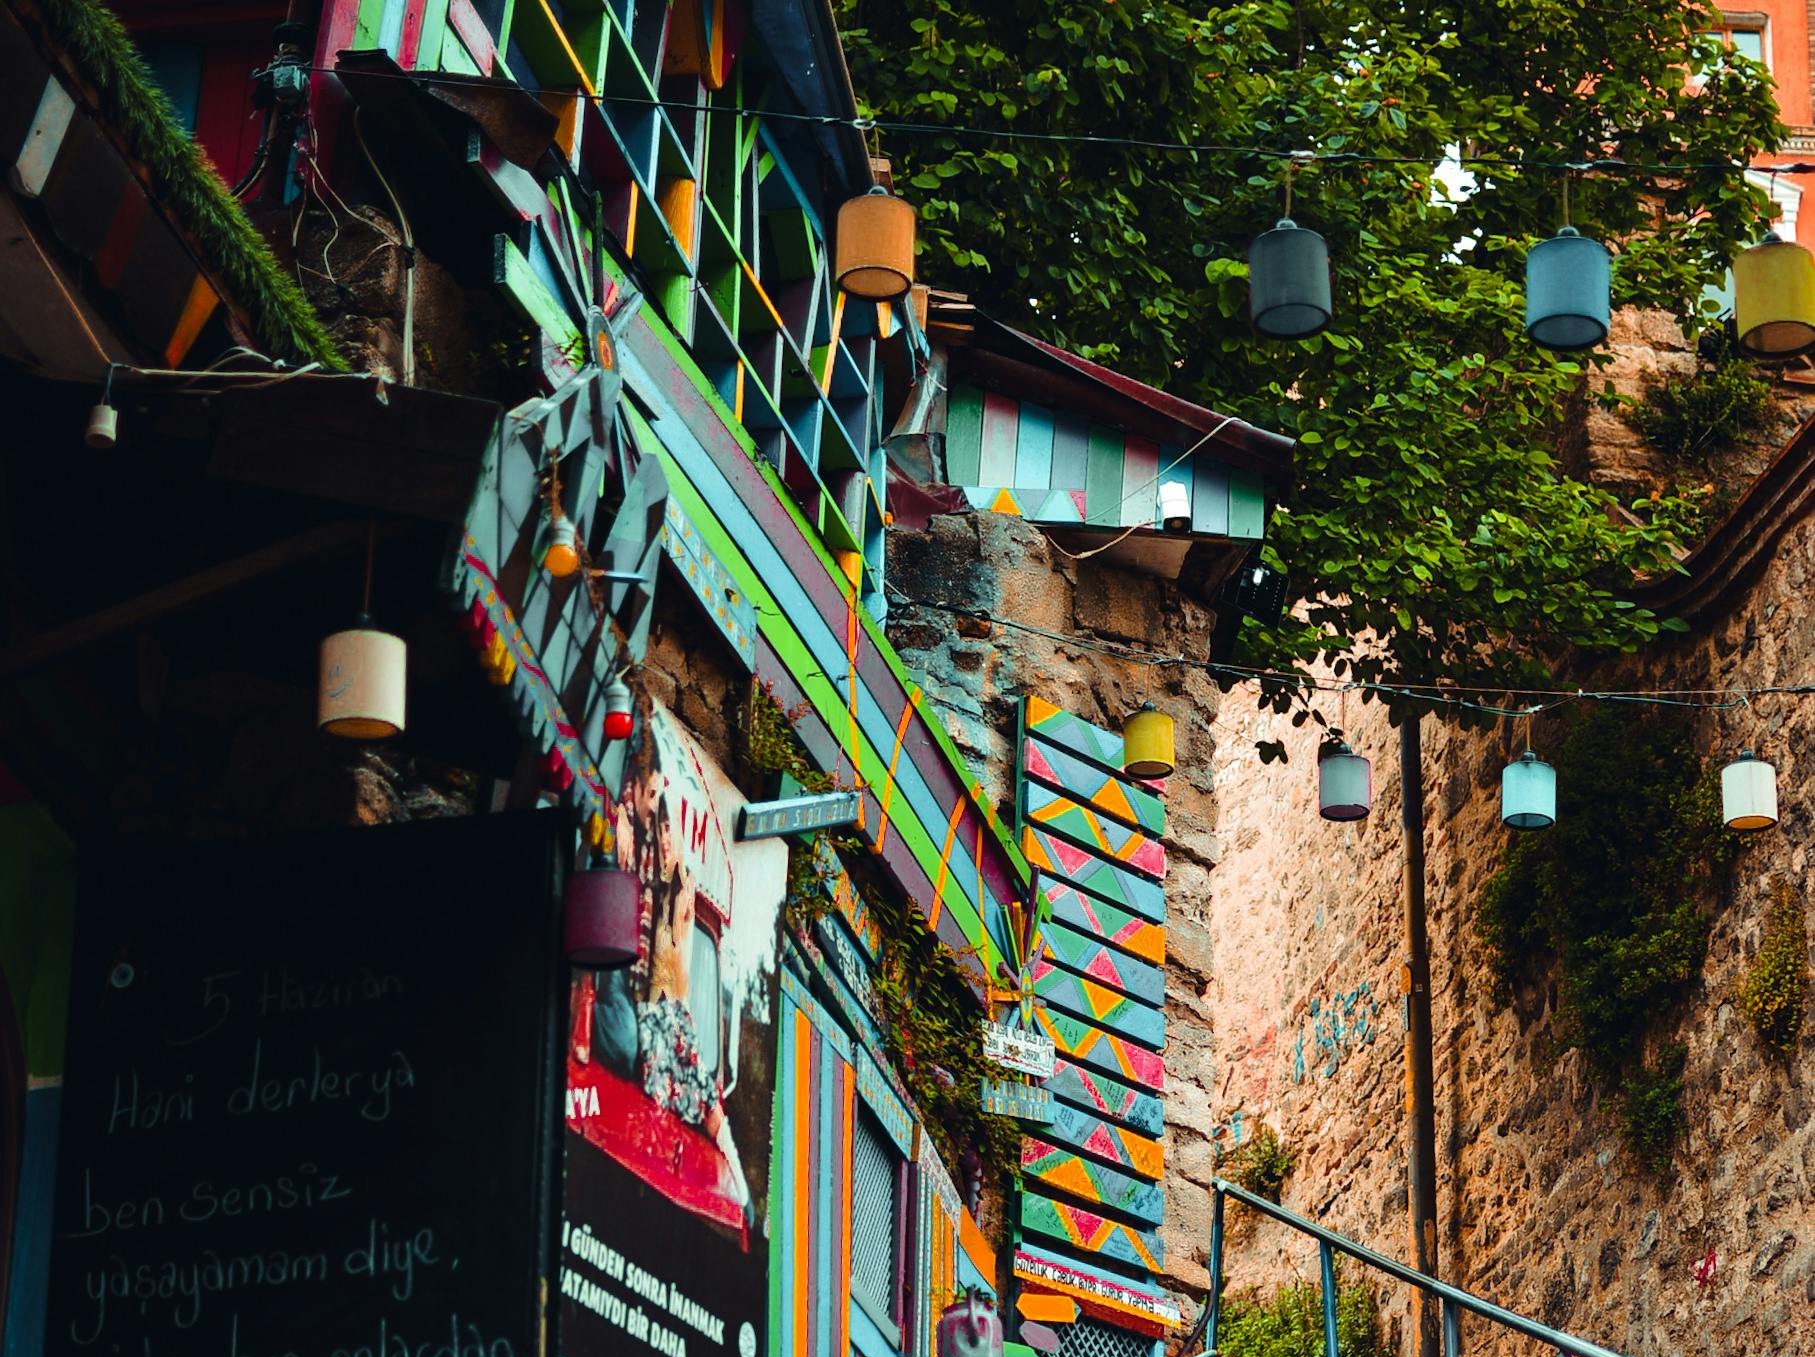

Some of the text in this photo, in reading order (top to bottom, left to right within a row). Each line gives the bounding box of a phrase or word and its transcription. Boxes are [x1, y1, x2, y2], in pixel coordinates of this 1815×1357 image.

[107, 1064, 196, 1136] Hani
[56, 1168, 164, 1239] ben
[70, 1250, 328, 1345] yaşayamam
[570, 1223, 626, 1282] GÜNDEN
[625, 1261, 668, 1311] SONRA
[669, 1281, 725, 1346] İNANMAK
[627, 1305, 650, 1343] BİR
